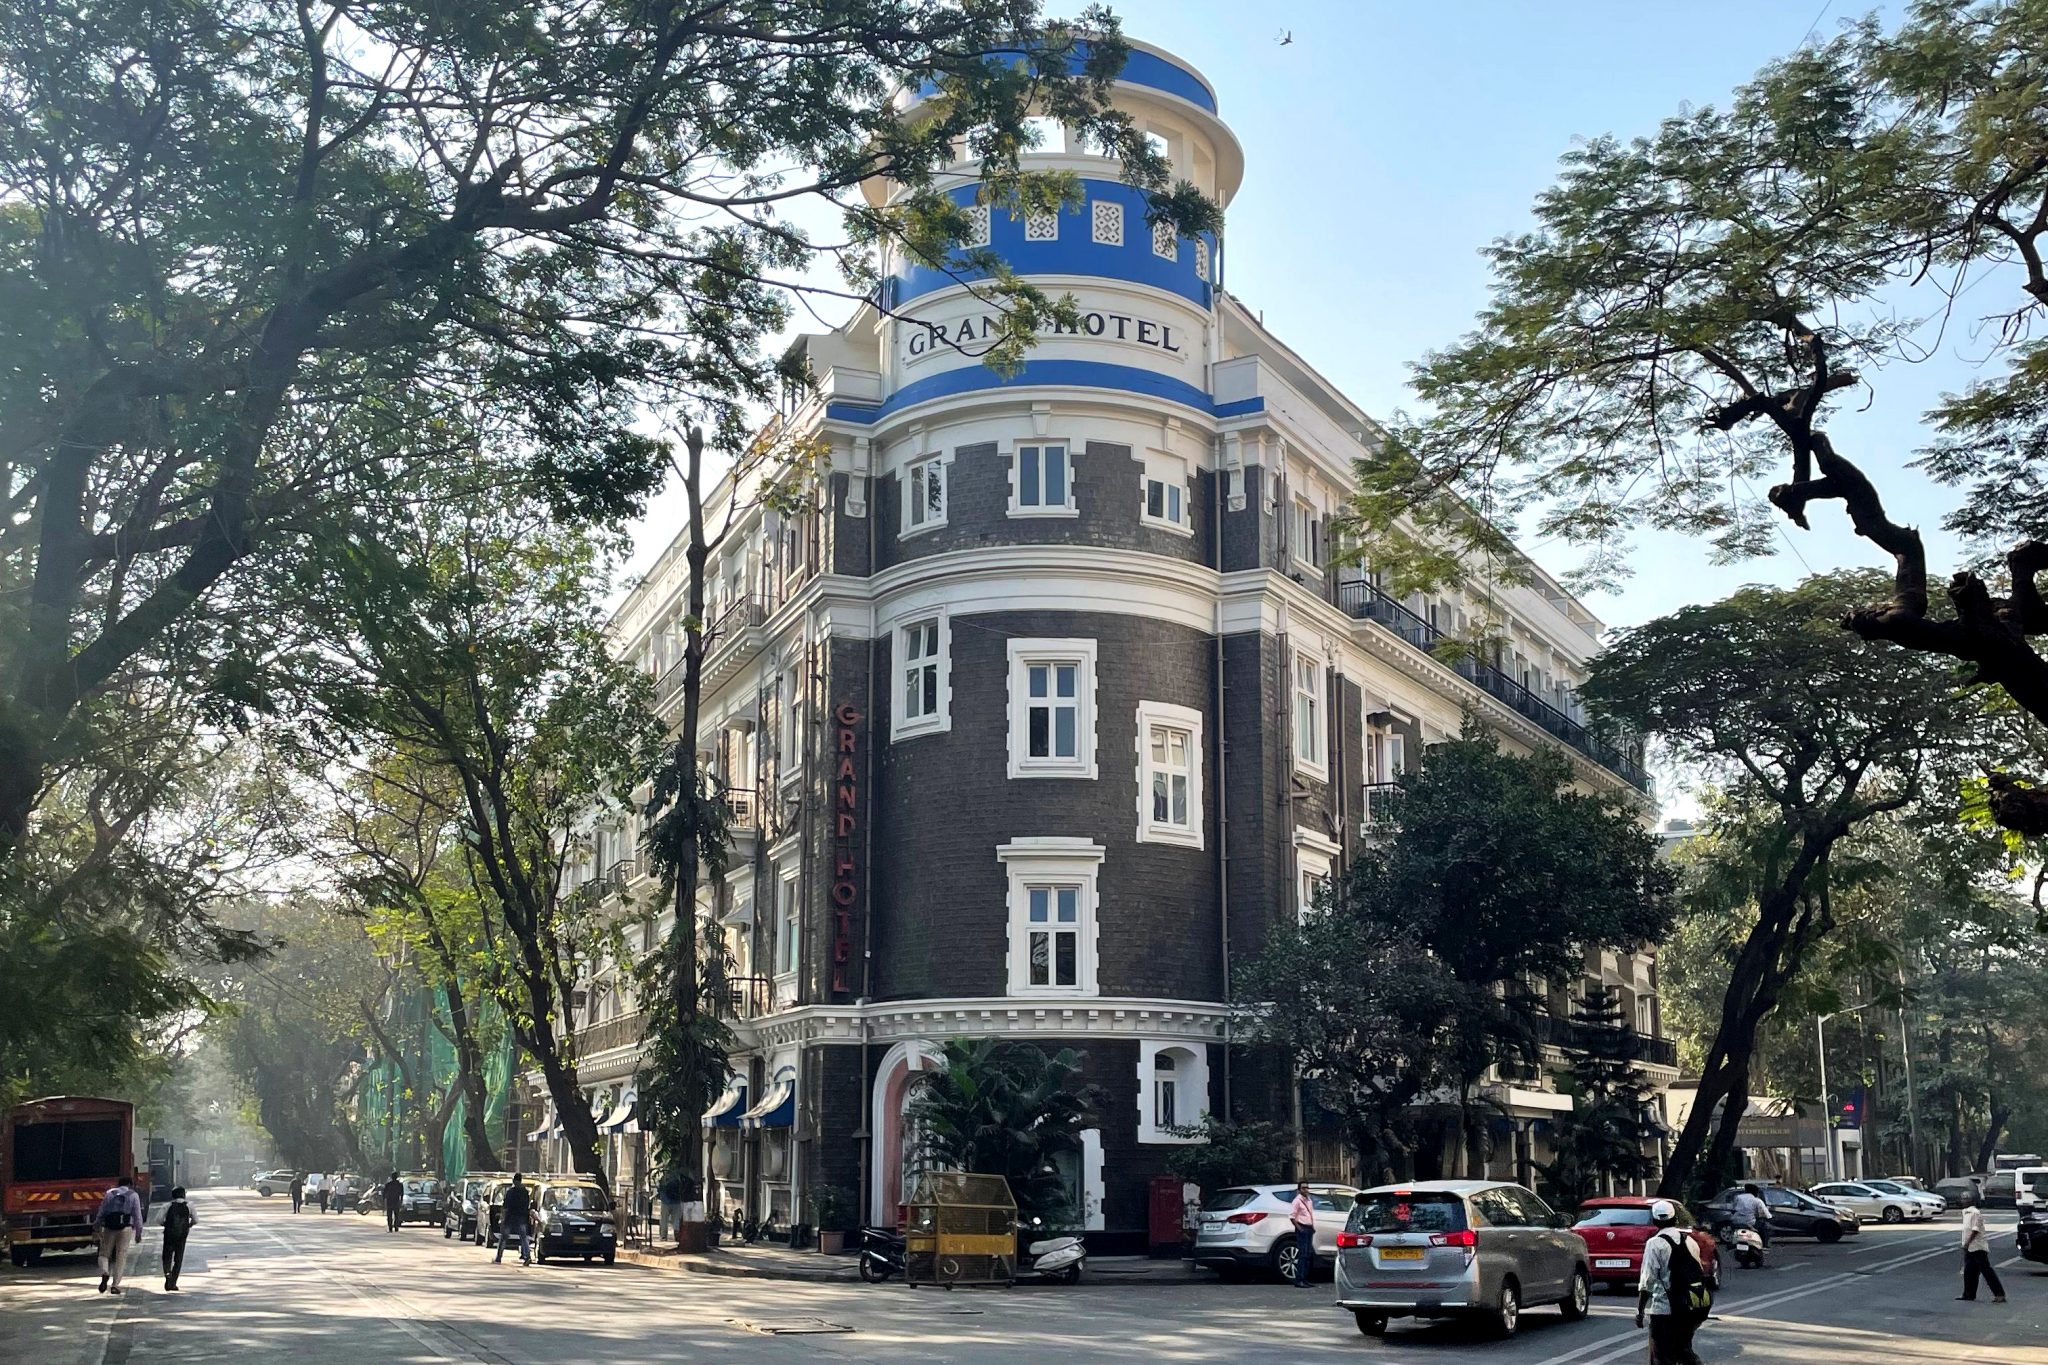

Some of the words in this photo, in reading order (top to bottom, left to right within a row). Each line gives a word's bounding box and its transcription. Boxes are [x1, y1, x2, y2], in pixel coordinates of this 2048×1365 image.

[908, 313, 1036, 356] GRAN
[636, 592, 658, 626] GRAND
[666, 556, 688, 593] HOTEL
[836, 703, 863, 837] GRAND
[832, 855, 857, 993] HOTEL
